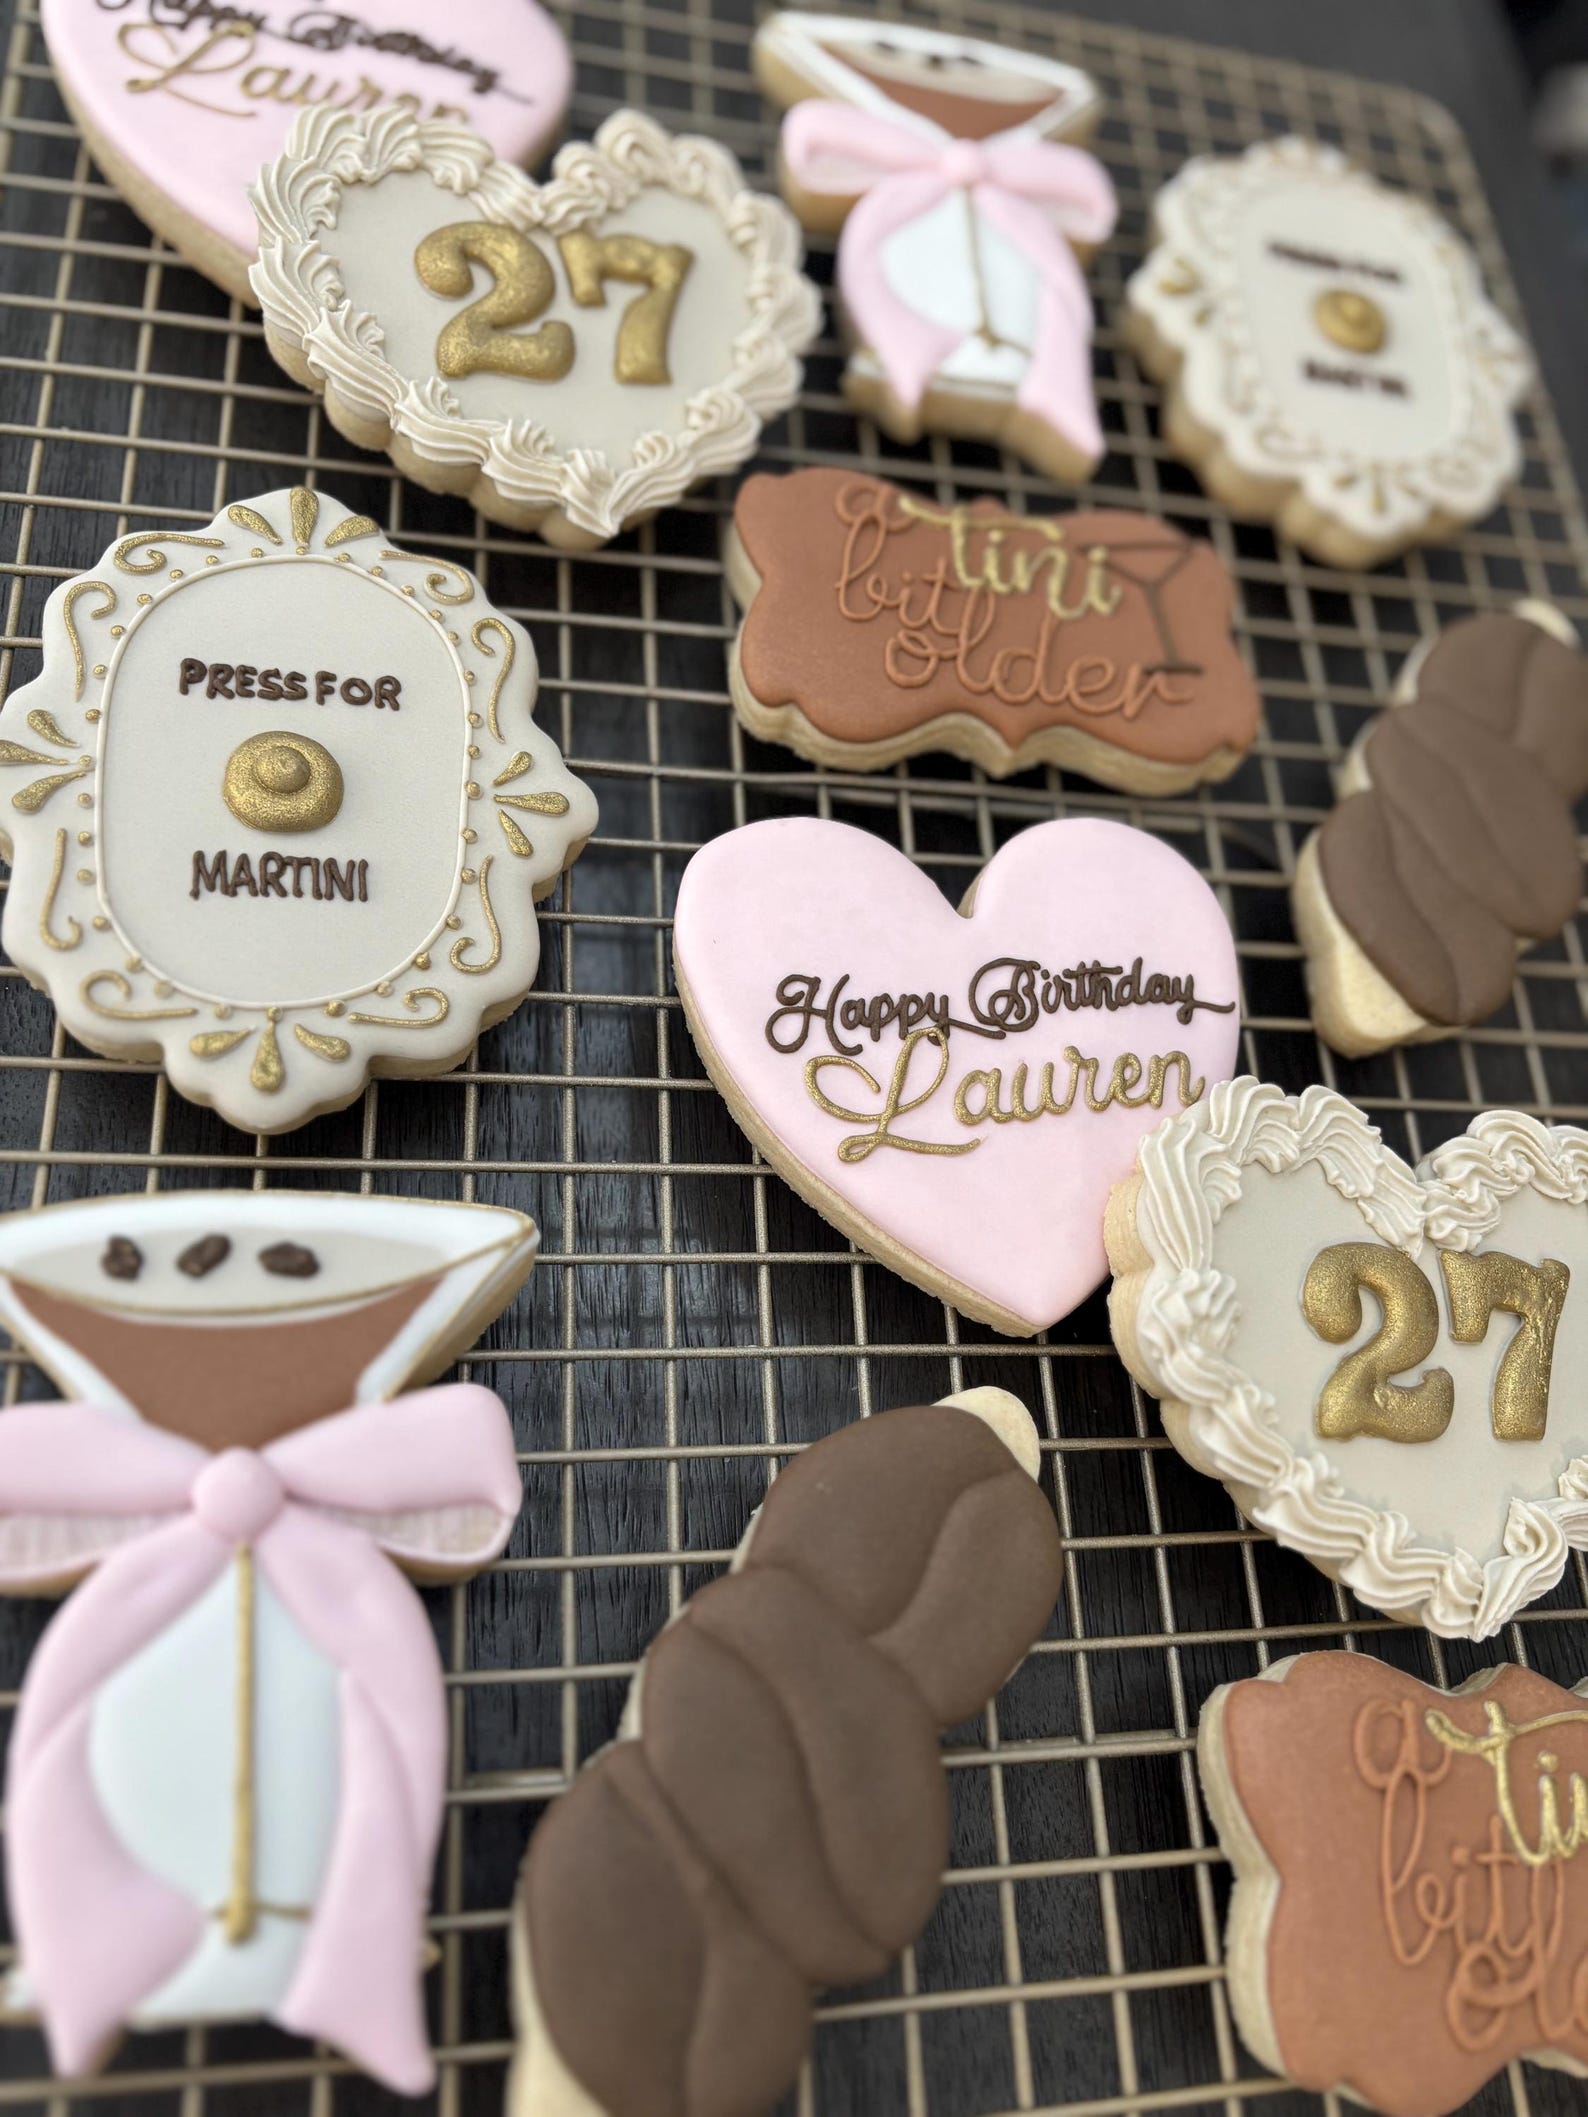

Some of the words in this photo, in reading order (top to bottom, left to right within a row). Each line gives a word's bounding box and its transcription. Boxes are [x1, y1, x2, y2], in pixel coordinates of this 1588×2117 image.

[414, 222, 693, 386] 27
[836, 482, 915, 533] a
[899, 498, 1122, 619] tini
[836, 513, 962, 635] bit
[179, 657, 308, 700] PRESS
[315, 669, 402, 711] FOR
[886, 585, 1194, 719] older
[189, 849, 369, 902] MARTINI
[765, 973, 1006, 1055] Happy
[968, 957, 1235, 1032] Birthday
[804, 1027, 1205, 1163] Lauren
[1303, 1241, 1571, 1443] 27
[1354, 1699, 1452, 1789] a
